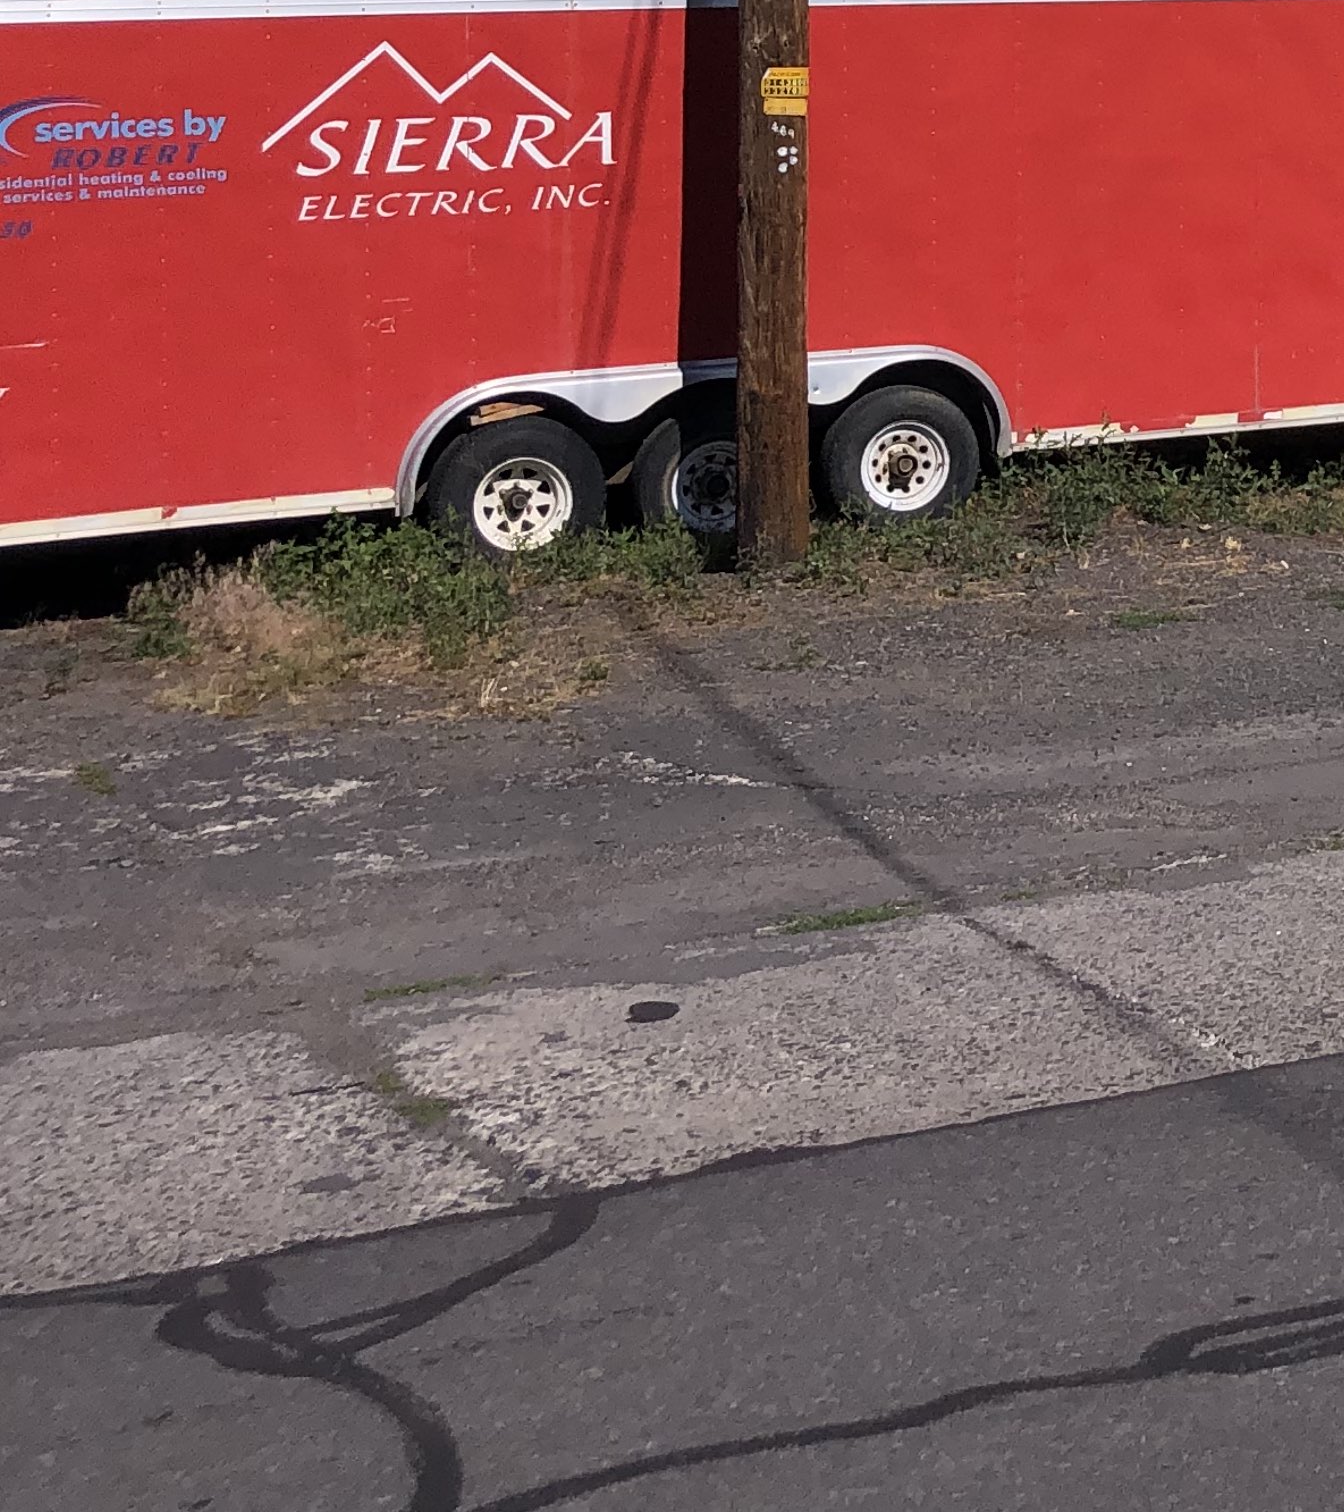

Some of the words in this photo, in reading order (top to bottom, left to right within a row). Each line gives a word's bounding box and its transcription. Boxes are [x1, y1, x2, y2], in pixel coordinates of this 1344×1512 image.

[34, 112, 174, 143] services
[183, 108, 227, 142] by
[52, 142, 205, 170] ROBERT
[296, 112, 618, 177] SIERRA
[80, 169, 144, 187] heating
[150, 170, 162, 182] &
[168, 167, 228, 182] cooling
[3, 187, 73, 204] services
[79, 188, 91, 199] &
[98, 183, 206, 199] maintenance
[298, 188, 513, 221] ELECTRIC,
[531, 183, 610, 211] INC.
